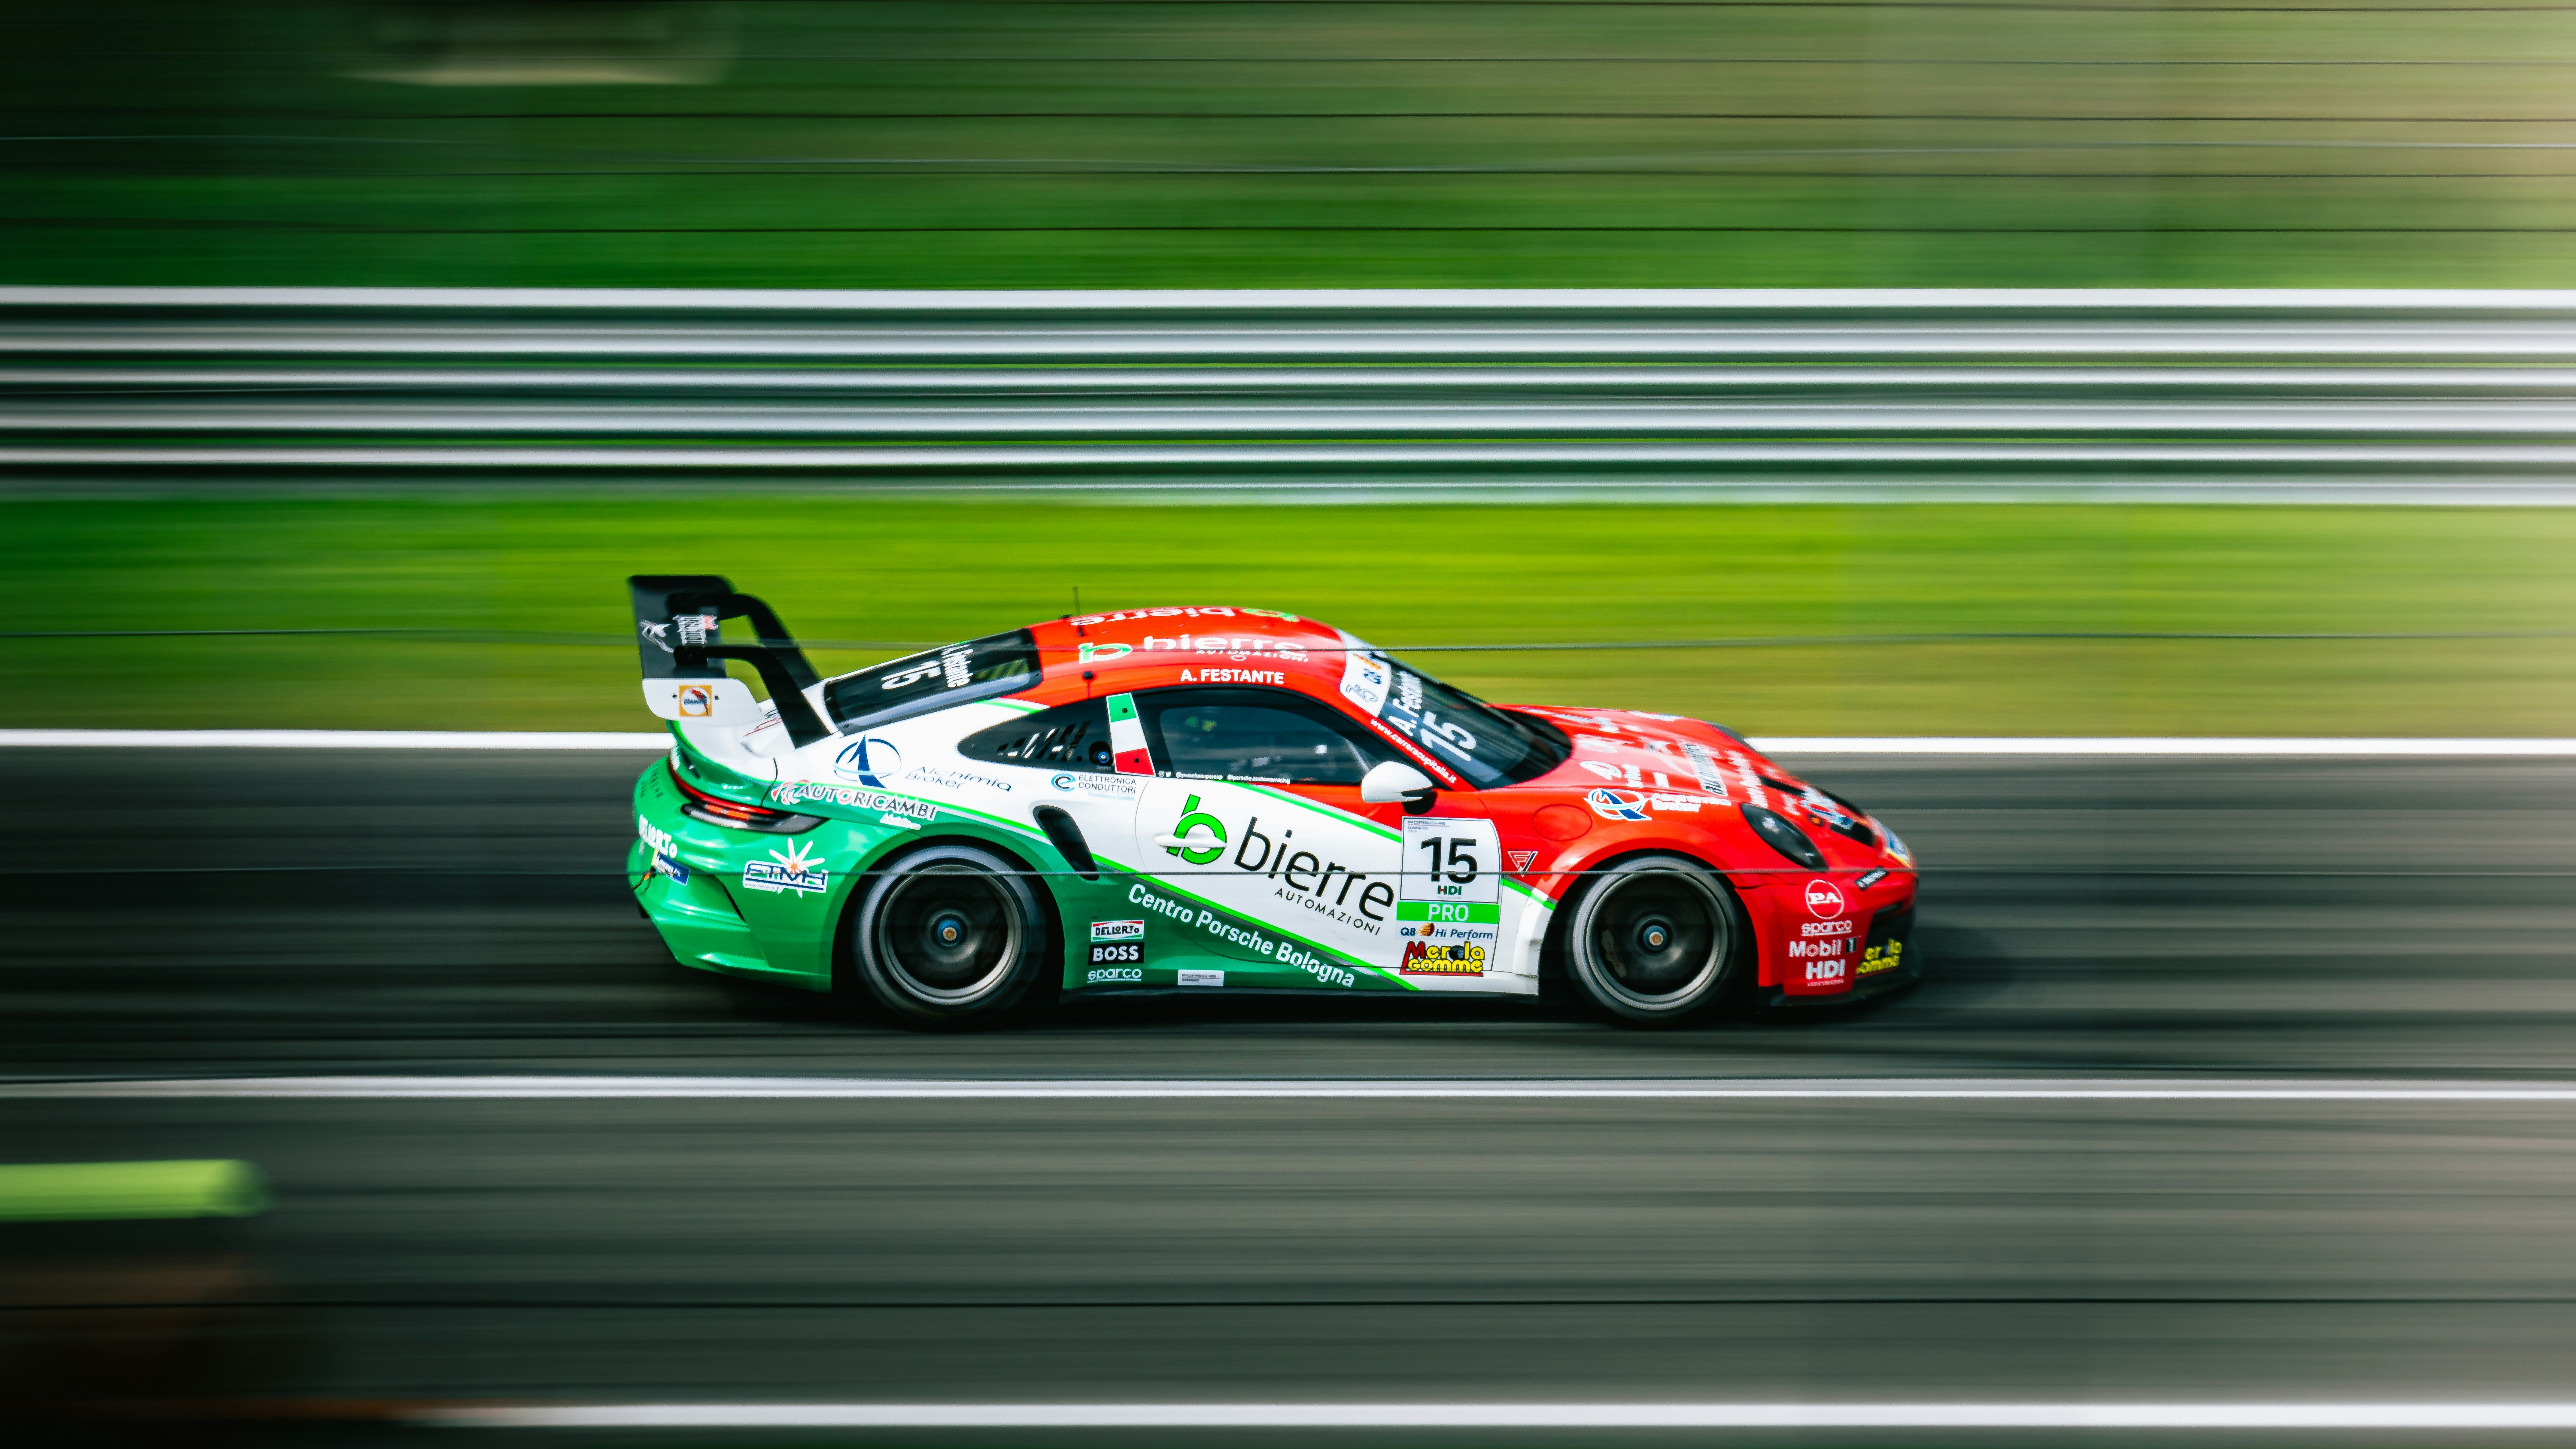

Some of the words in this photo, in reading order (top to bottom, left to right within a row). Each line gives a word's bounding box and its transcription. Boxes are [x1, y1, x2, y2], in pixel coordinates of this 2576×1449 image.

[1143, 634, 1308, 658] bierre
[881, 660, 942, 690] 15
[1181, 669, 1197, 682] A.
[1200, 668, 1285, 684] FESTANTE
[1419, 711, 1477, 762] 15
[1370, 719, 1457, 784] www.carreracupitalia.it
[905, 773, 965, 789] Broker
[910, 766, 1012, 792] Alchimia
[1078, 775, 1136, 785] ELETTRONICA
[1078, 783, 1136, 793] CONDUTTORI
[797, 786, 937, 820] AUTORICAMBI
[1234, 817, 1394, 921] bierre
[1421, 837, 1478, 884] 15
[1437, 885, 1462, 896] HDI
[1807, 891, 1842, 905] PA
[1274, 887, 1381, 936] AUTOMAZIONI
[1428, 904, 1469, 922] PRO
[1129, 884, 1193, 923] Centro
[1195, 910, 1274, 955] Porsche
[1276, 941, 1355, 987] Bologna
[1400, 927, 1416, 937] Q8
[1435, 929, 1447, 938] Hi
[1450, 929, 1493, 940] Perform
[1801, 920, 1853, 936] sparco
[1093, 945, 1139, 961] BOSS
[1789, 939, 1842, 957] Mobil
[1848, 938, 1856, 953] 1
[1088, 969, 1142, 982] sparco
[1805, 959, 1846, 979] HDI
